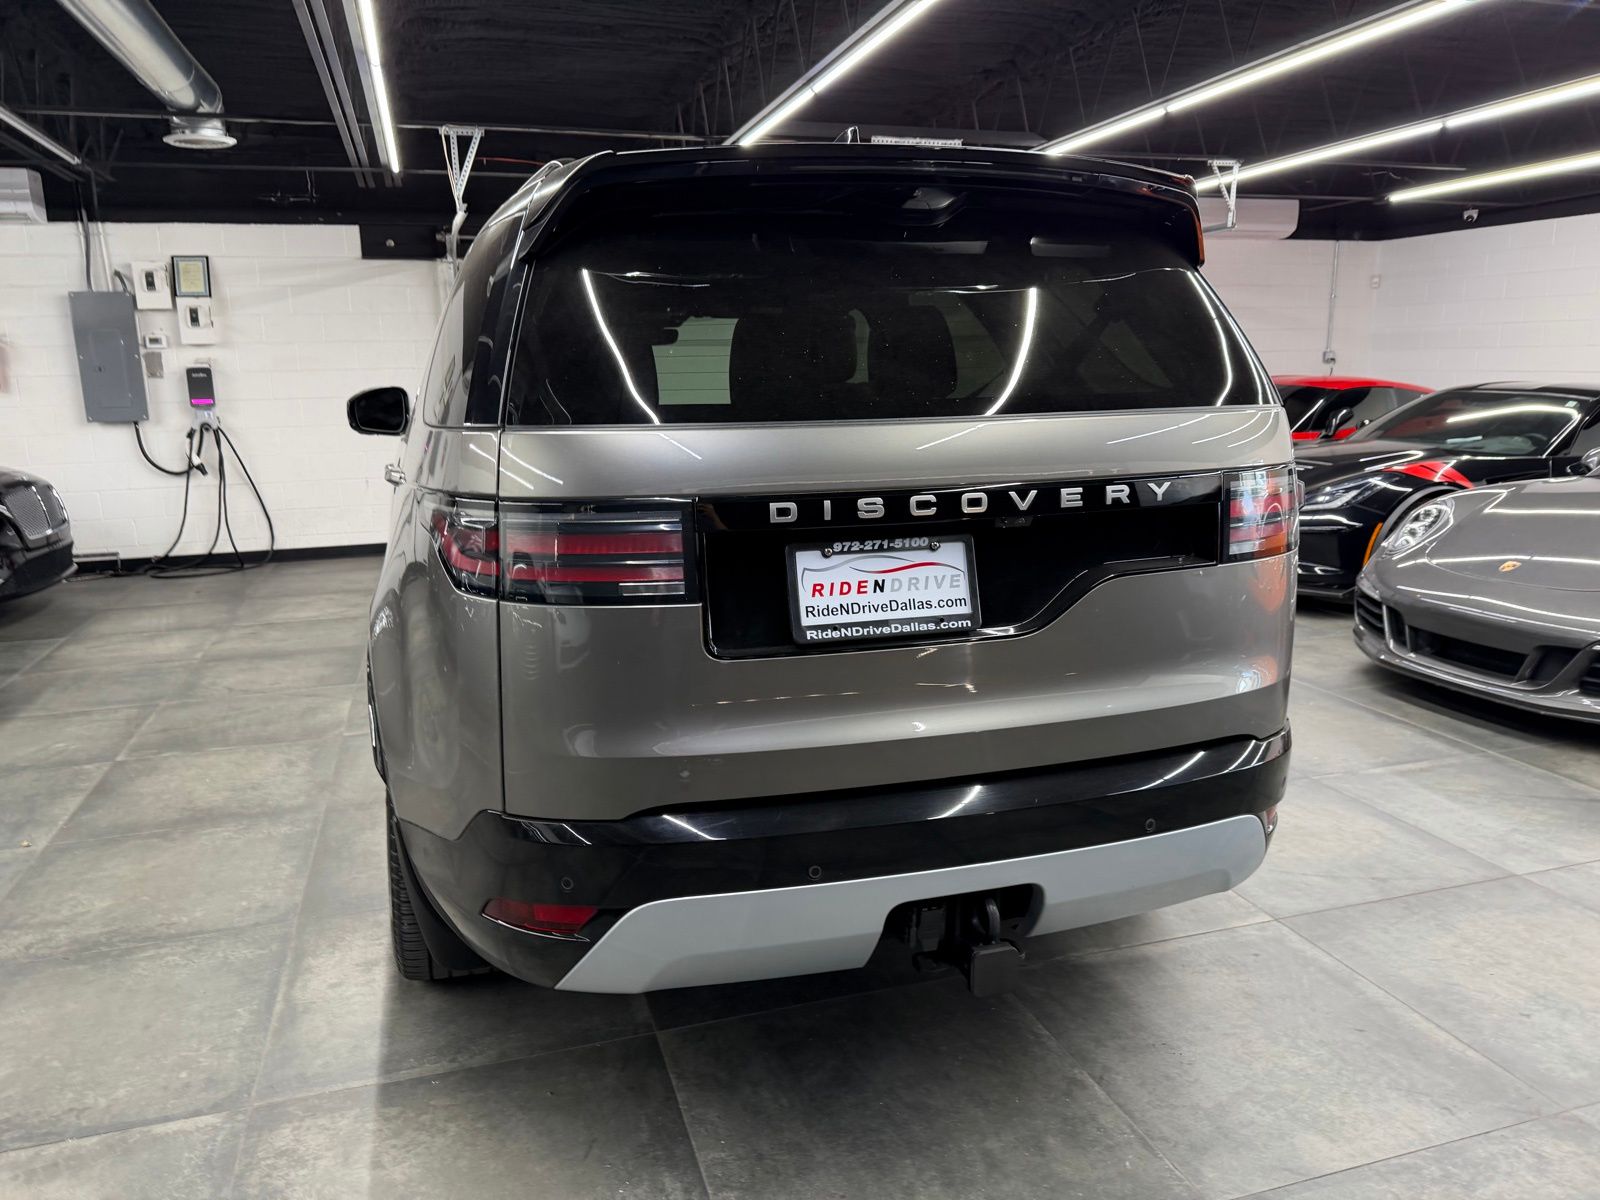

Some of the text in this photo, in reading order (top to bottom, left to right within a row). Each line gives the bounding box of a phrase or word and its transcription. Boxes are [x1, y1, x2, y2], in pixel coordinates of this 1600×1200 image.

[769, 482, 1171, 524] DISCOVERY
[832, 537, 929, 552] 972-271-5100
[805, 597, 967, 618] RideNDriveDallas.com
[806, 620, 972, 640] RideNDriveDallas.com
